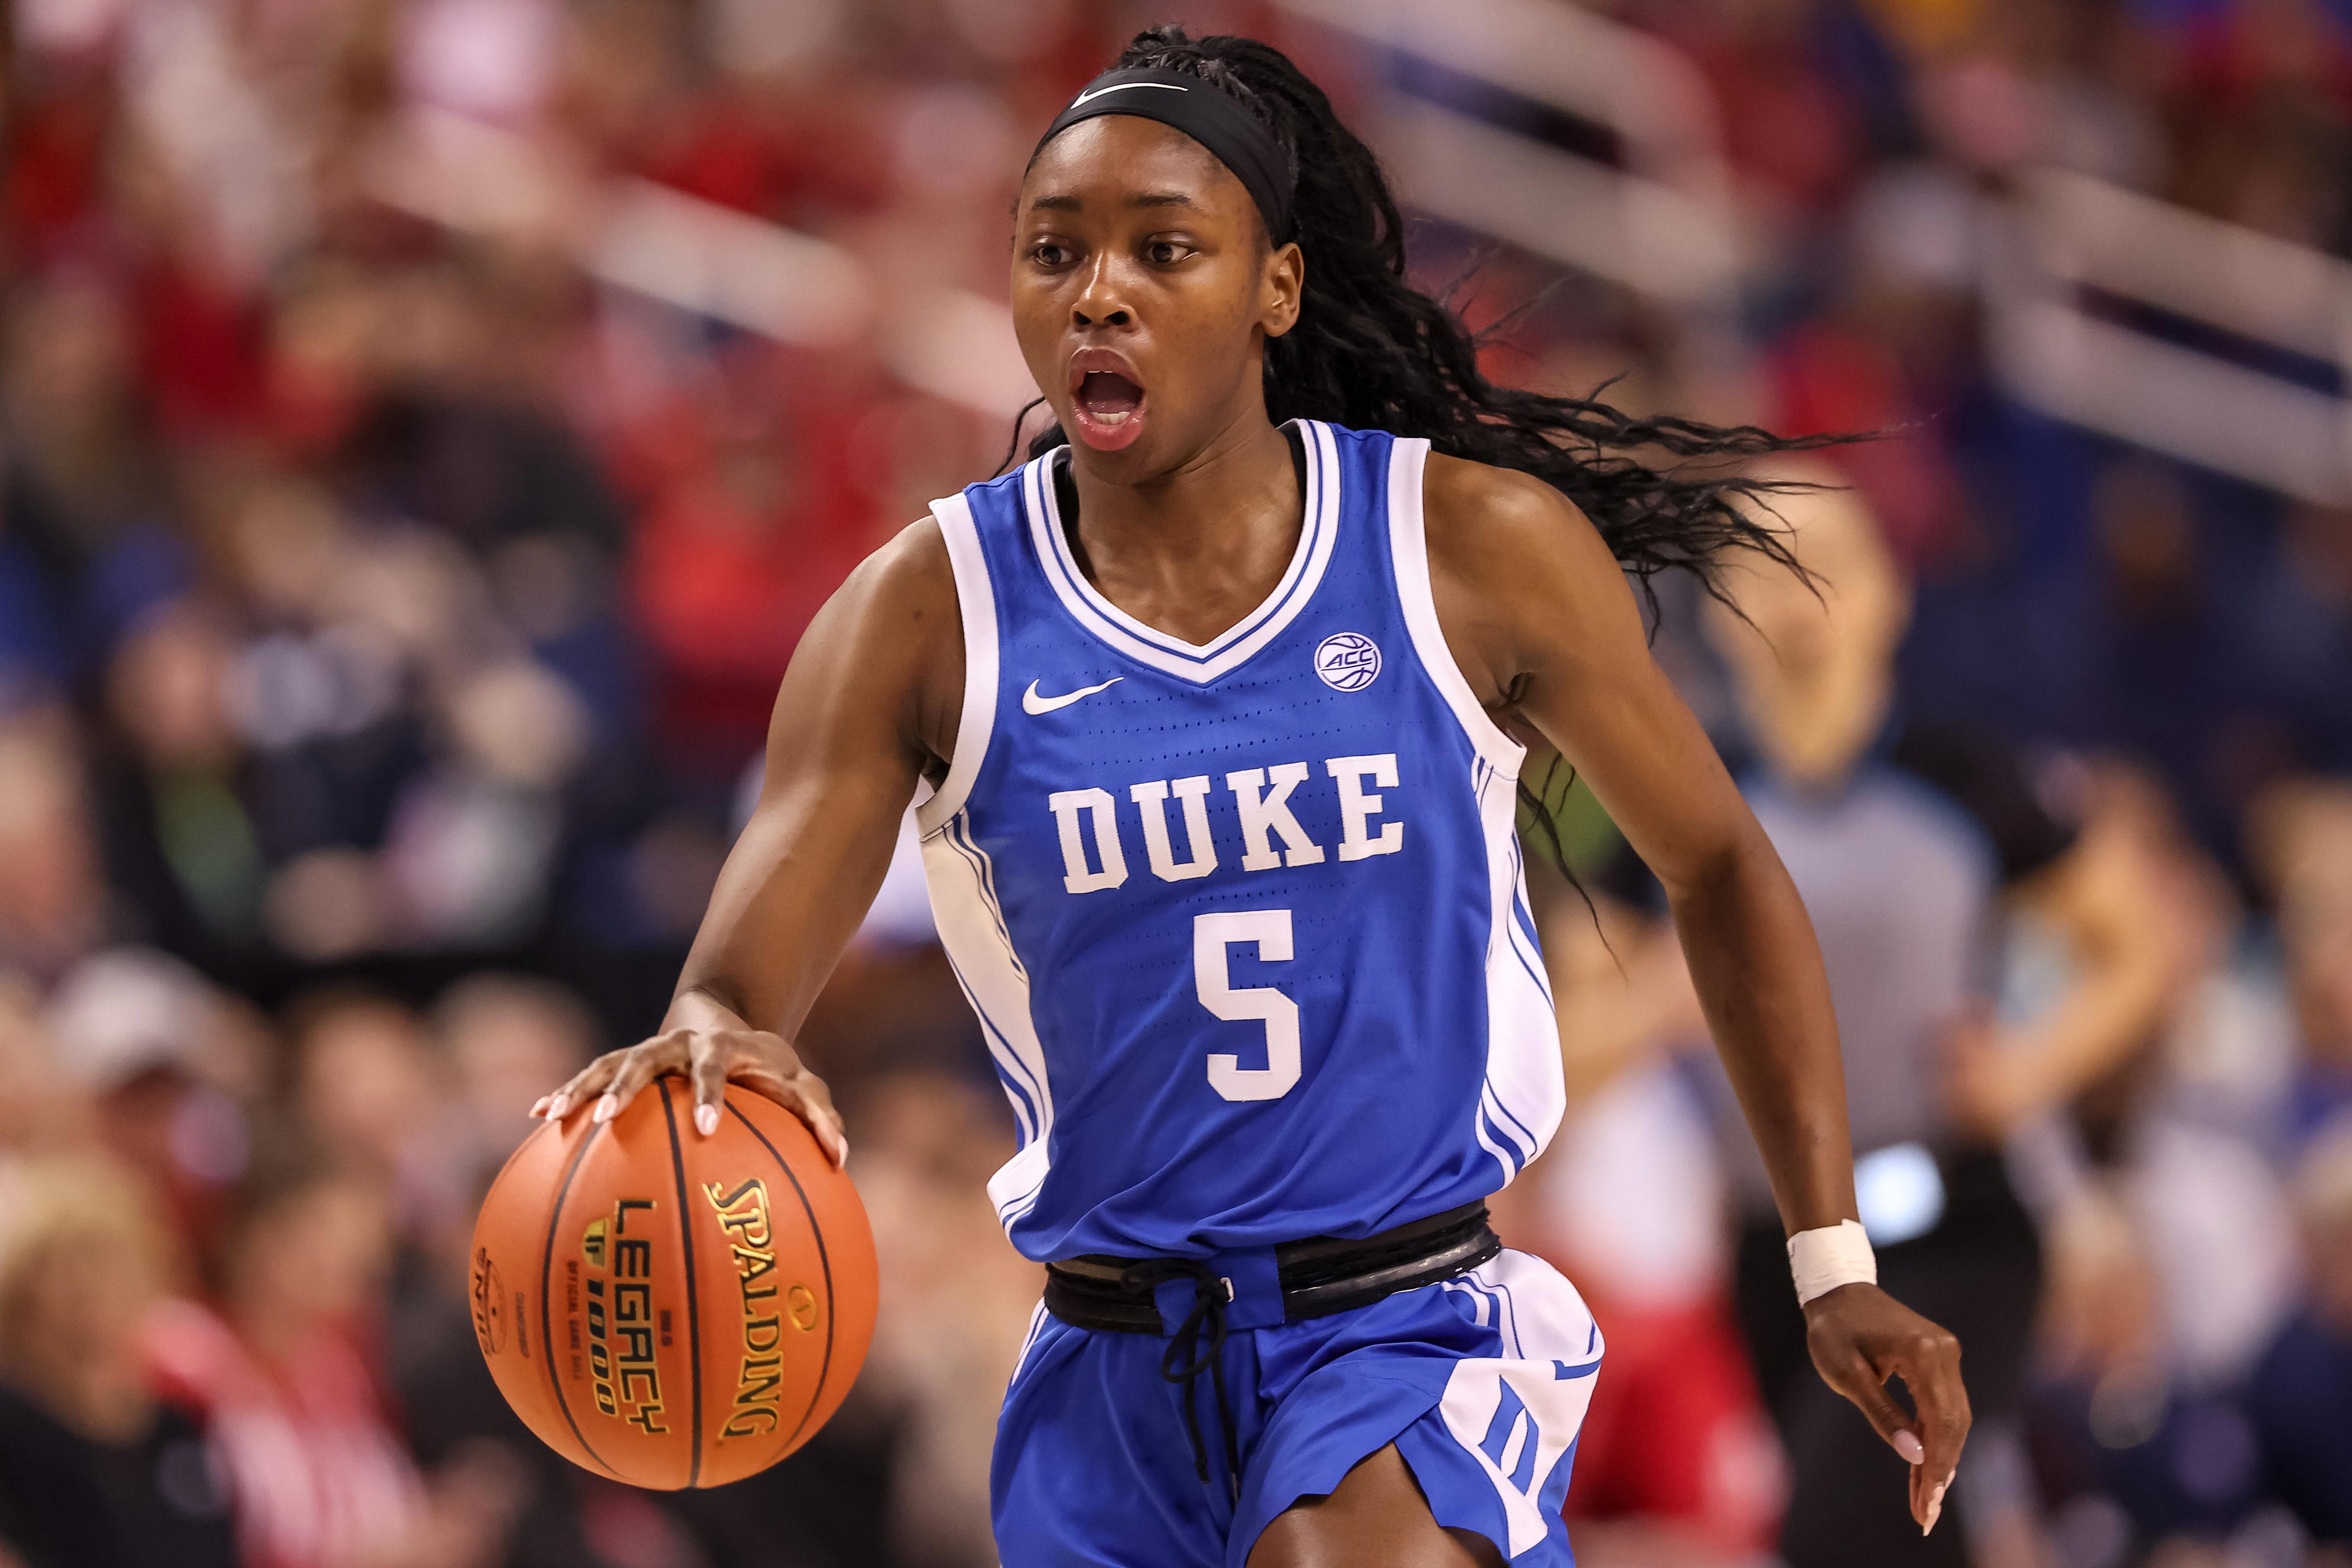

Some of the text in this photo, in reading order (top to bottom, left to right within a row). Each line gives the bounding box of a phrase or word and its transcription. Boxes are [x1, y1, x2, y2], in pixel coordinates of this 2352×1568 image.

[1324, 647, 1374, 667] ACC
[1049, 753, 1404, 894] DUKE
[1194, 909, 1302, 1101] 5
[614, 1200, 670, 1434] LEGACY
[702, 1177, 784, 1438] SPALDING
